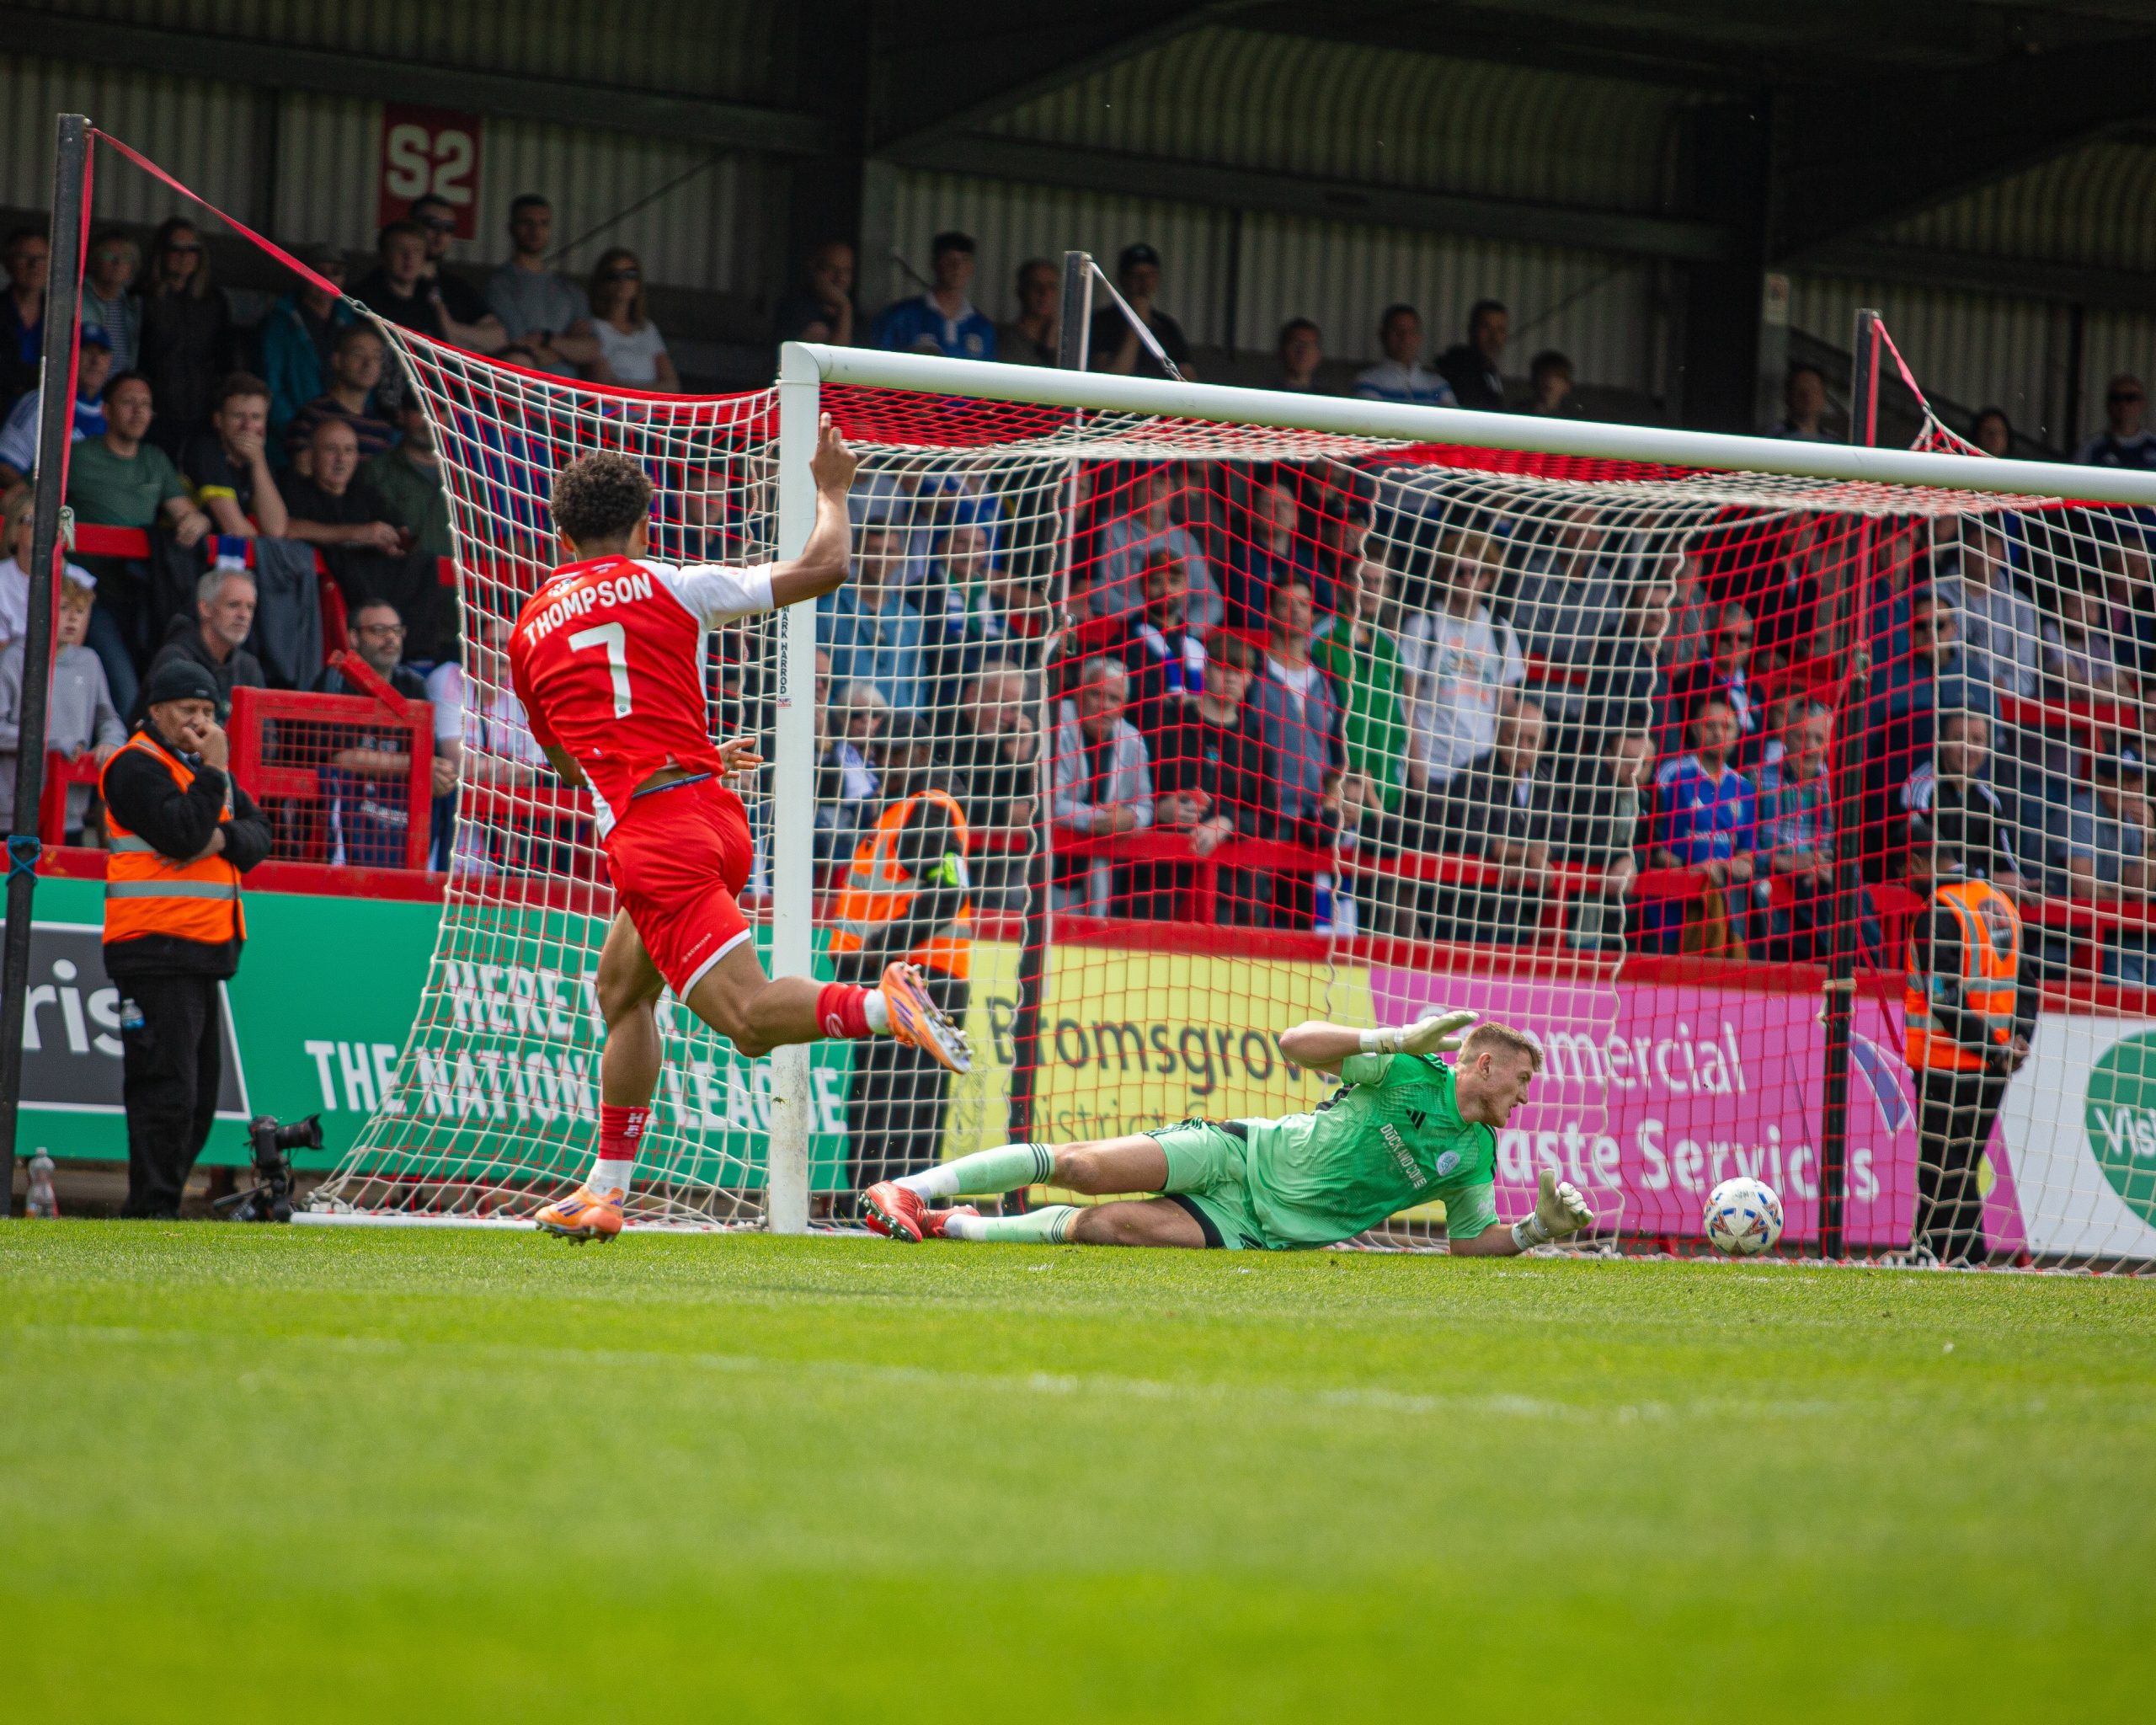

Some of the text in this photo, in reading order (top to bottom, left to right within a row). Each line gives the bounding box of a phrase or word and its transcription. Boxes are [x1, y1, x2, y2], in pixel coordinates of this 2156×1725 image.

[385, 123, 474, 204] S2
[522, 572, 654, 647] THOMPSON
[567, 622, 633, 720] 7
[779, 642, 788, 695] HARROD
[22, 959, 125, 1057] ris
[445, 960, 574, 1037] HERE
[304, 1039, 408, 1114] THE
[985, 995, 1341, 1096] Bromsgrov
[1396, 1147, 1415, 1168] AND
[1498, 1117, 1881, 1204] aste Servics
